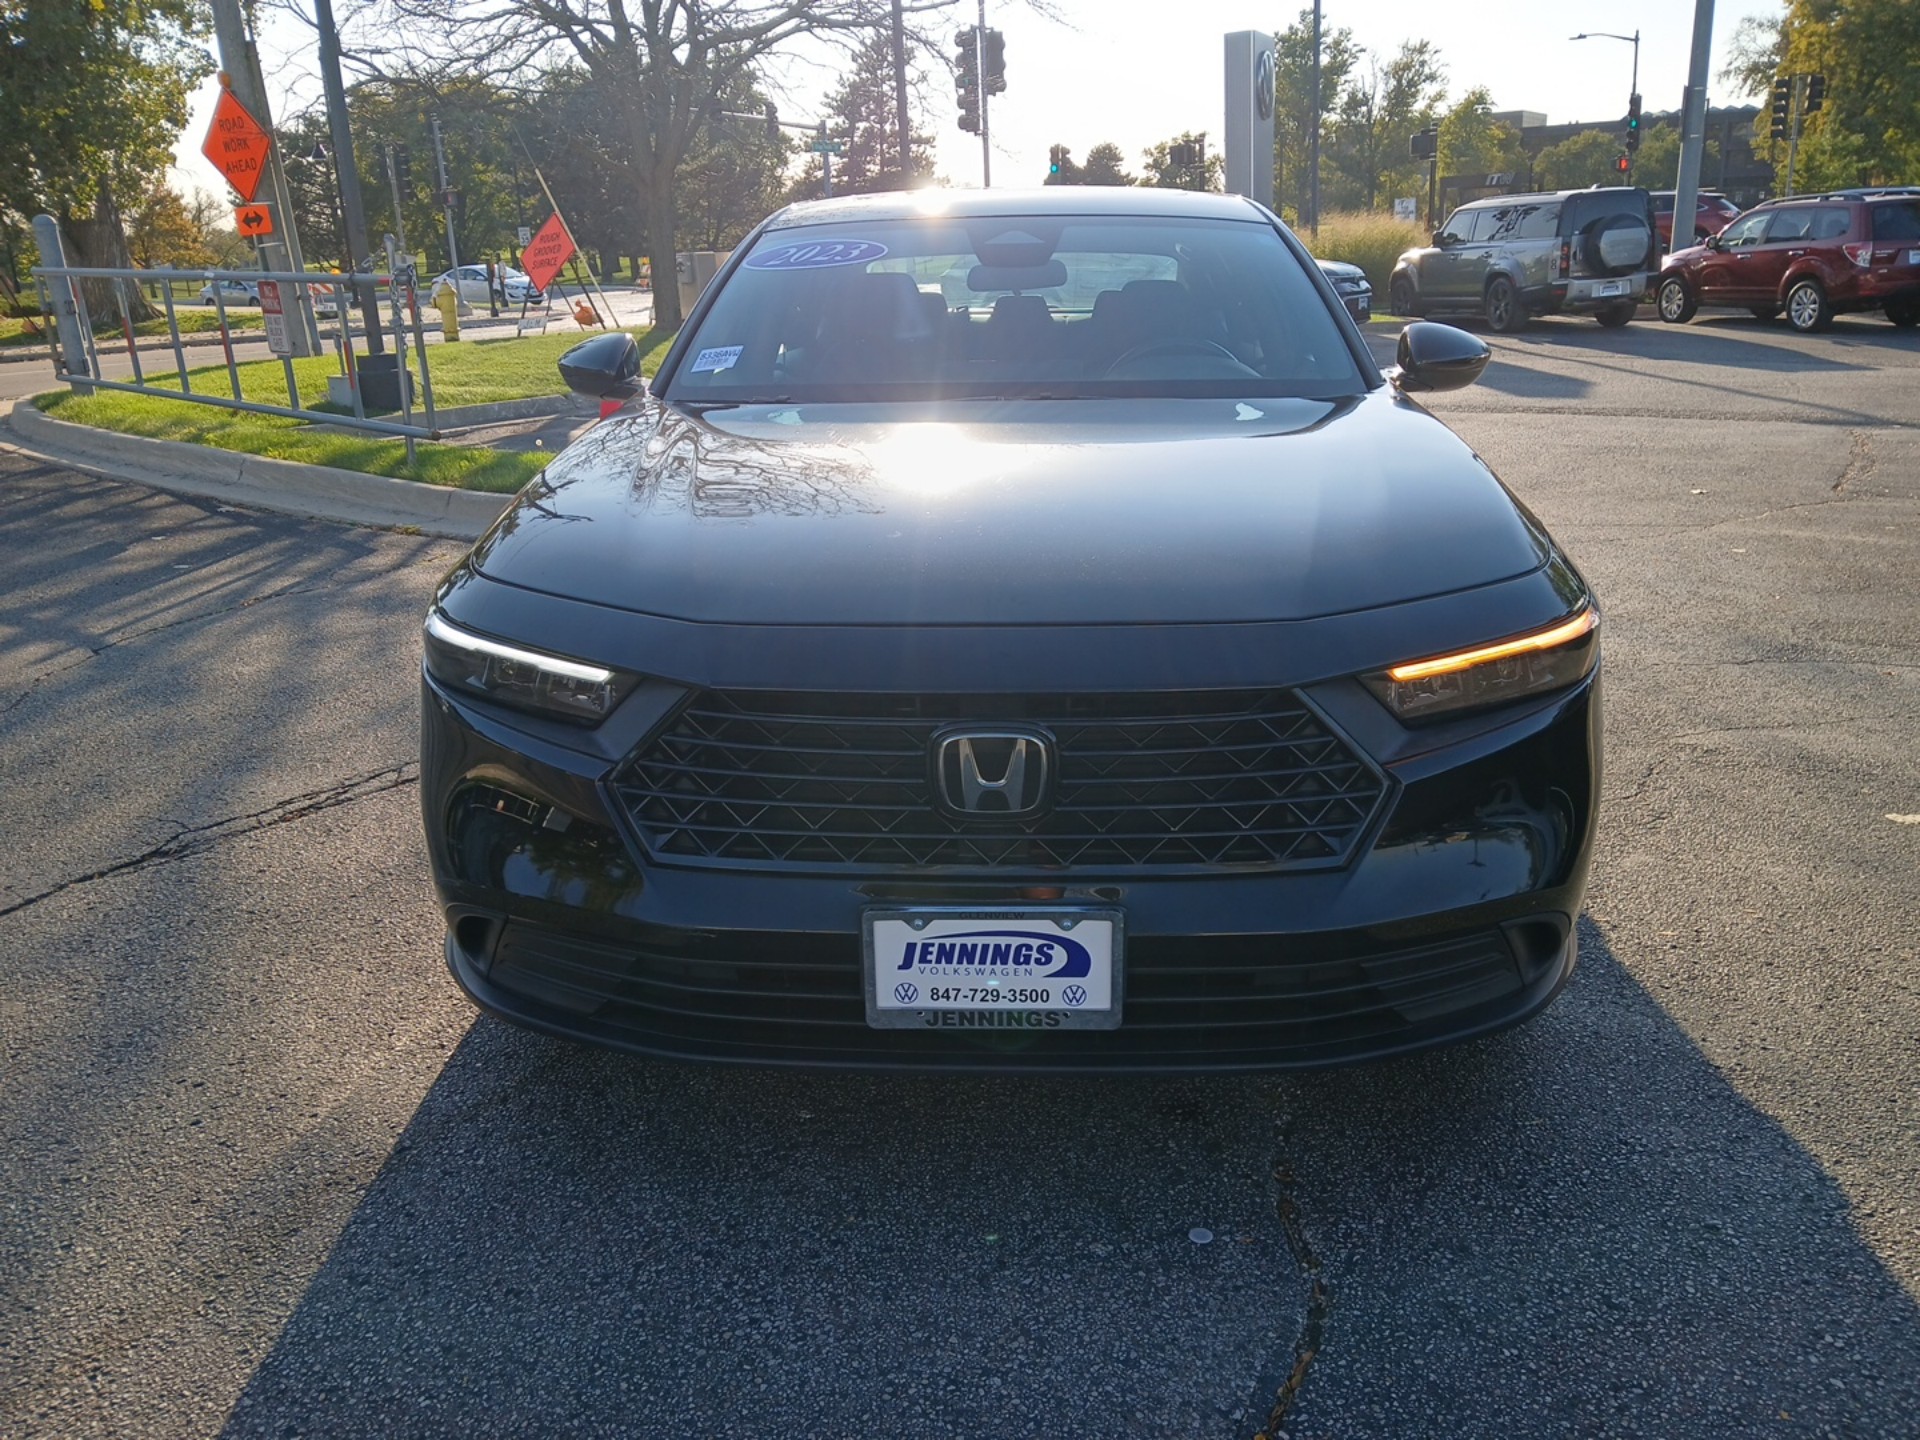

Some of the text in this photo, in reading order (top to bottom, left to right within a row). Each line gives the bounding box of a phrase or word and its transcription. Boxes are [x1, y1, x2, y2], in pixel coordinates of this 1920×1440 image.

[218, 116, 245, 132] ROAD
[222, 138, 250, 153] WORK
[226, 158, 257, 174] AHEAD
[540, 233, 560, 244] ROUGH
[534, 244, 561, 256] GROOVED
[764, 244, 868, 265] 2023
[532, 257, 558, 269] SURFACE
[897, 941, 1056, 970] JENNINGS
[917, 966, 1034, 977] VOLKSWAGEN
[929, 987, 1051, 1003] 847-729-3500
[925, 1011, 1060, 1027] JENNINGS
